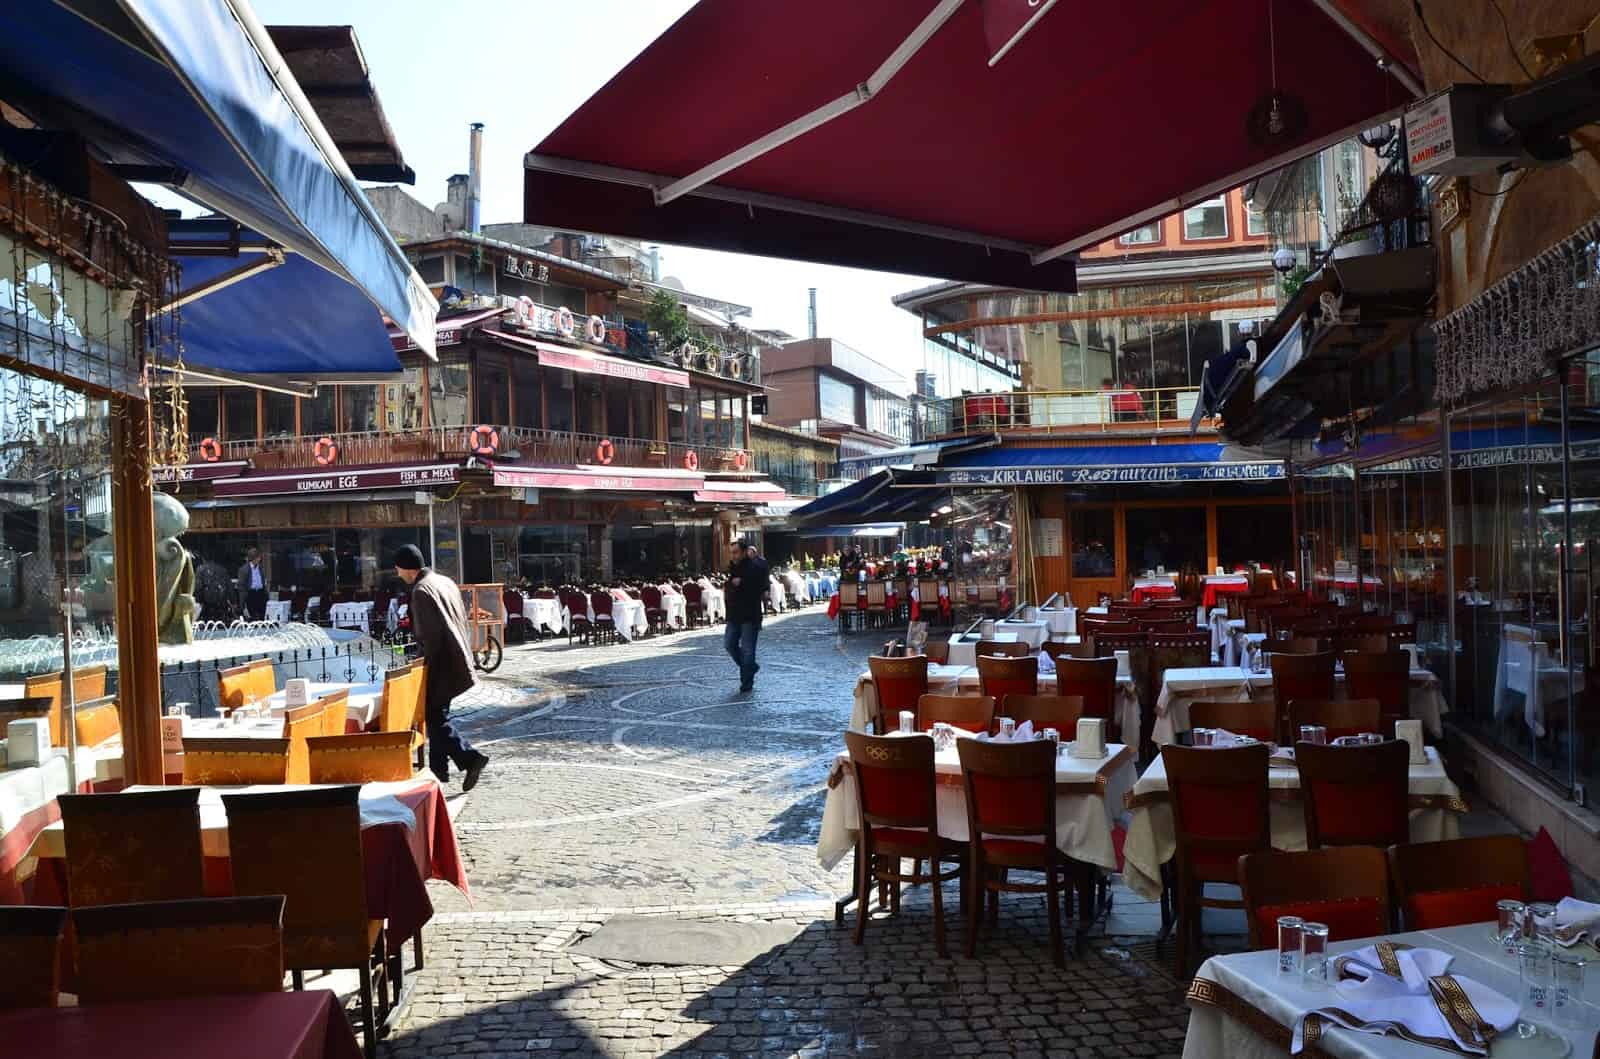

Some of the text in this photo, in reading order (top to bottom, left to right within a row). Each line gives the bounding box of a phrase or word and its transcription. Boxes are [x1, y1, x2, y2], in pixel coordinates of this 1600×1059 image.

[507, 256, 549, 282] EGE
[400, 471, 416, 481] FISH
[432, 468, 454, 478] MEAT
[297, 476, 358, 490] KUMKAPI EGE
